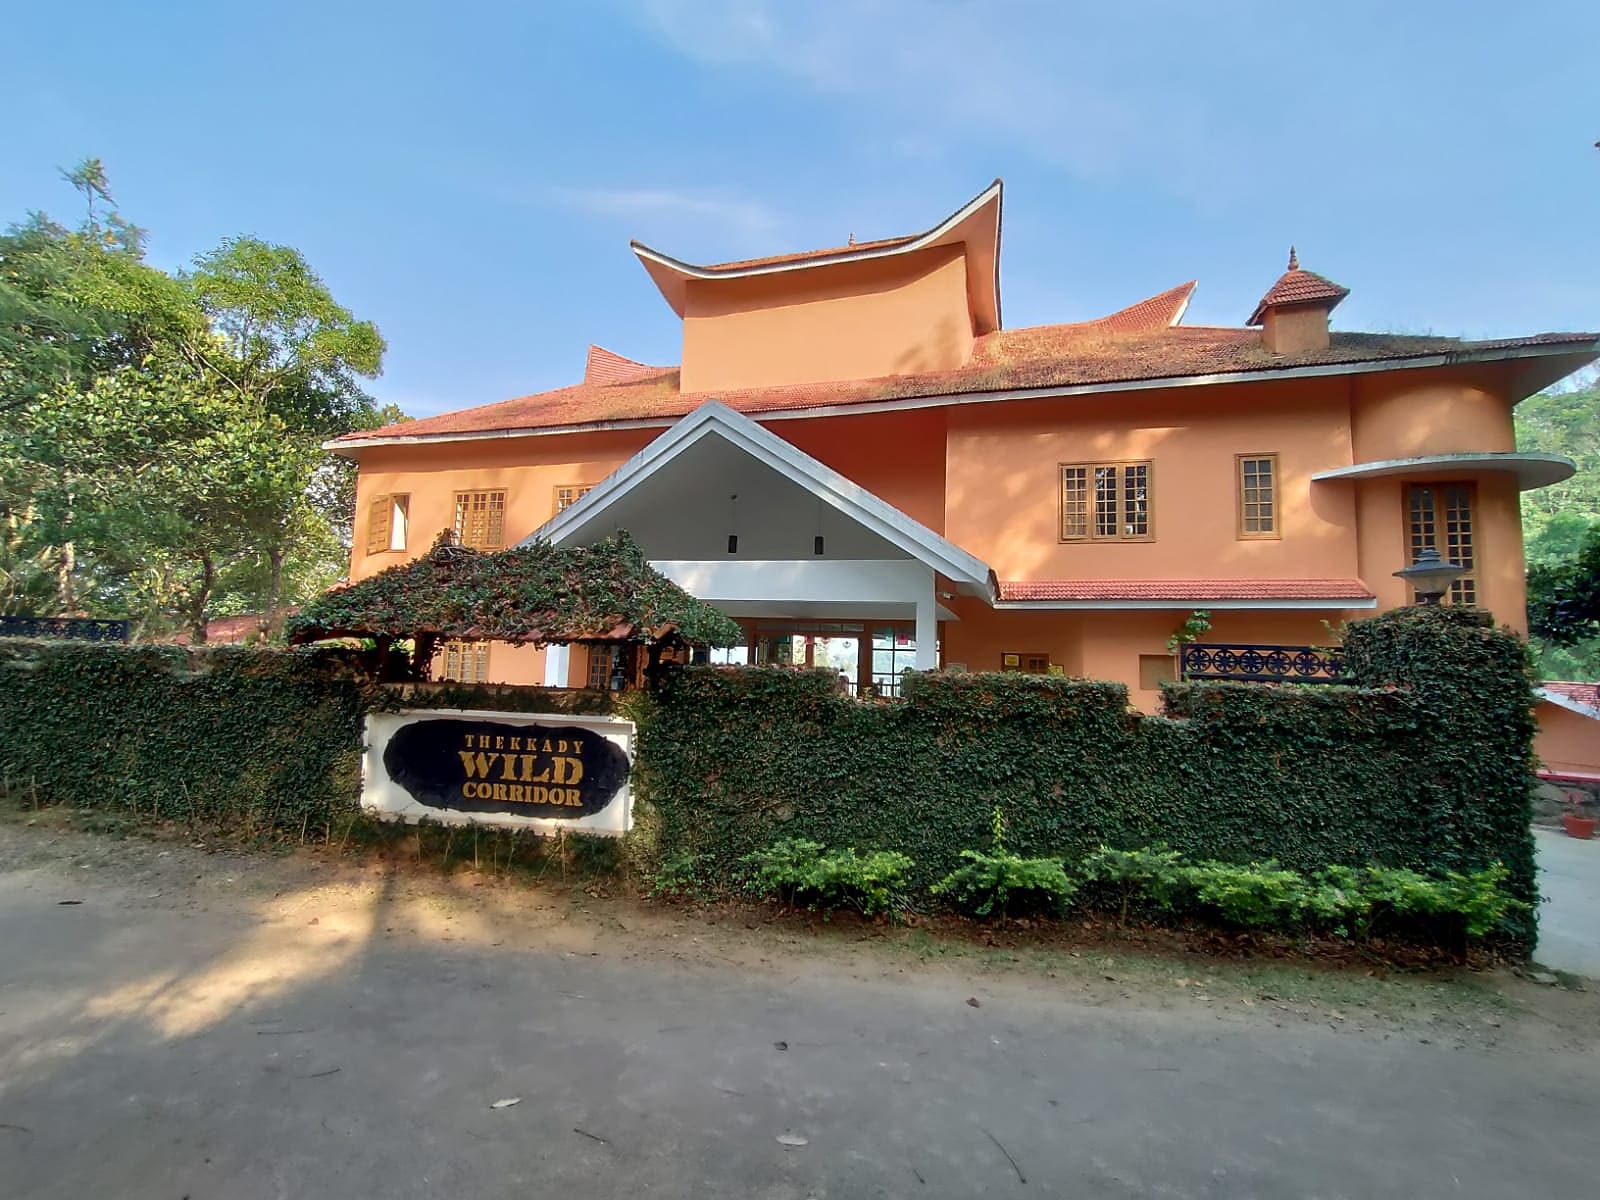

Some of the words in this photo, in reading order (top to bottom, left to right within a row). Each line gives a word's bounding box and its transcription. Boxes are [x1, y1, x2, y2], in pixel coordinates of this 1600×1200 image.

[465, 734, 584, 754] THEKKADY
[458, 750, 584, 785] WILD
[463, 782, 583, 807] CORRIDOR
